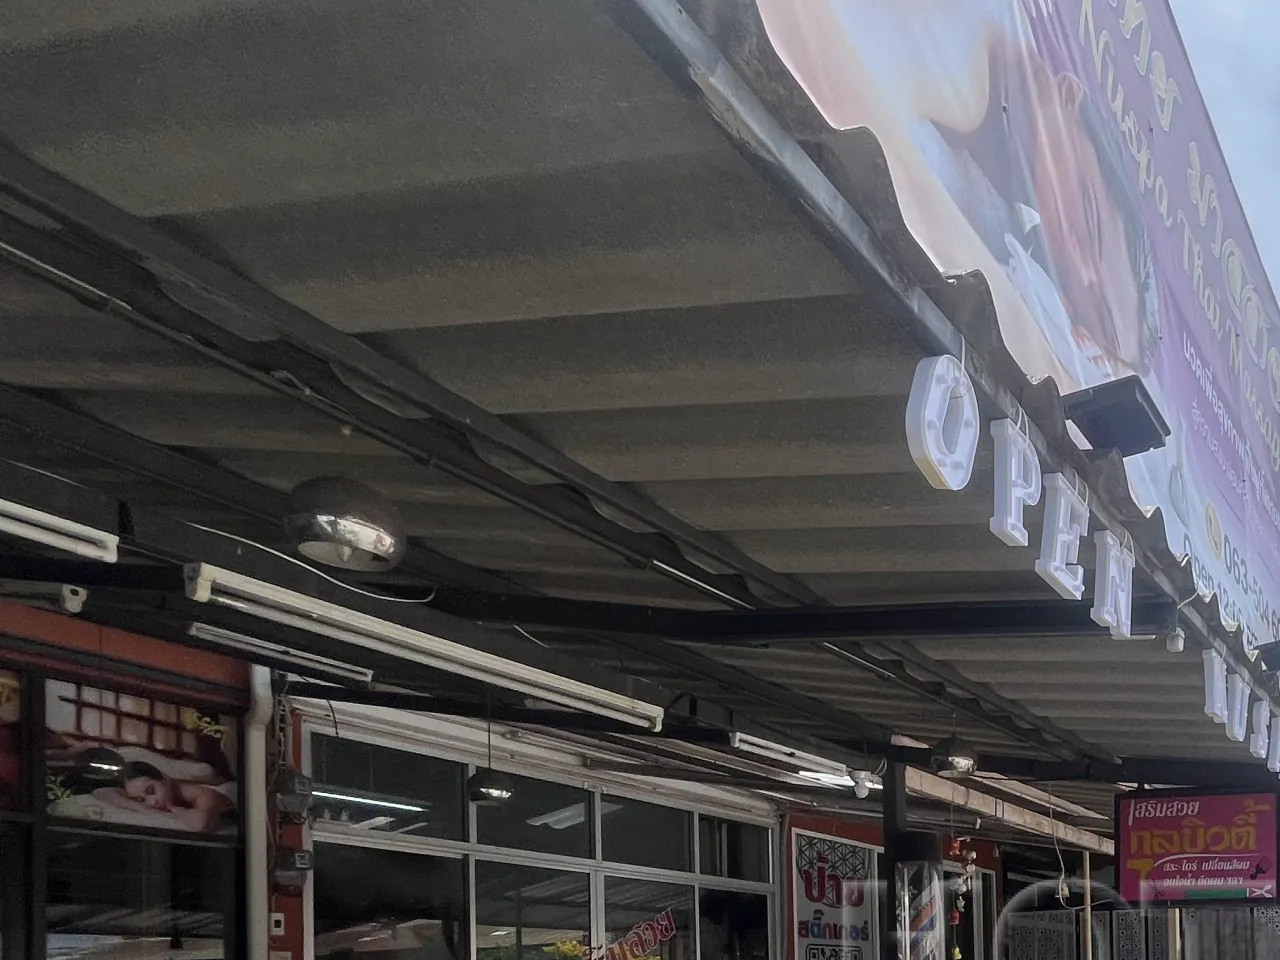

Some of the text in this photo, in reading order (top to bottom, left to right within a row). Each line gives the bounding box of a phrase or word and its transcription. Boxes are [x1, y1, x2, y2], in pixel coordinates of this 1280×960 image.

[905, 354, 1136, 638] OPEN
[1128, 799, 1200, 826] เสริมสวย
[802, 851, 865, 908] ป้าย
